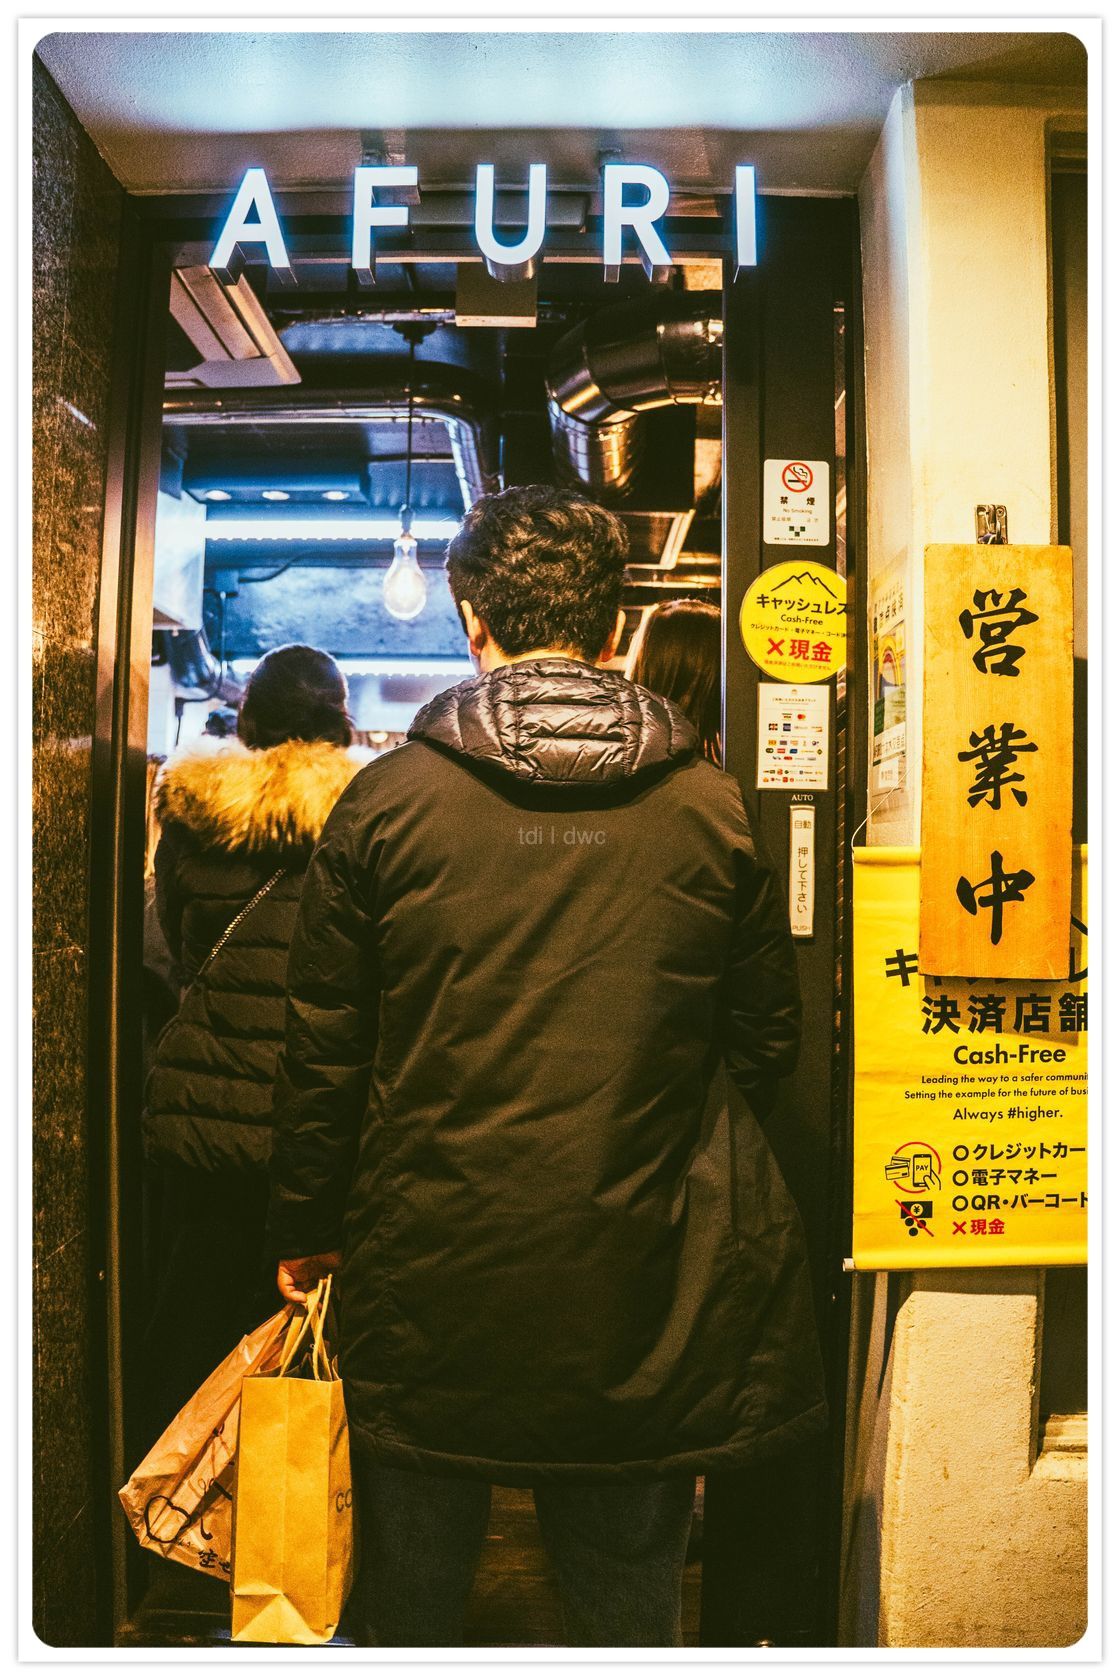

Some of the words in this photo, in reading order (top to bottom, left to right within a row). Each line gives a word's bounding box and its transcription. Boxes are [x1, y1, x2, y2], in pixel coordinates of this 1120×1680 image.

[209, 163, 757, 269] AFURI
[780, 614, 823, 625] Cash-Free
[956, 588, 1039, 945] 営業中
[794, 820, 811, 829] 自動
[797, 847, 808, 913] 押して下さい
[921, 992, 1088, 1035] 決済店舗
[953, 1044, 1066, 1065] Cash-Free
[921, 1075, 958, 1085] Leading
[961, 1075, 975, 1083] the
[978, 1076, 998, 1084] way
[1020, 1073, 1043, 1082] safer
[1045, 1072, 1088, 1081] communi
[904, 1091, 936, 1101] Setting
[939, 1090, 952, 1098] the
[955, 1089, 995, 1100] example
[998, 1089, 1011, 1098] for
[1013, 1088, 1028, 1097] the
[1030, 1087, 1056, 1097] future
[1059, 1086, 1069, 1095] of
[953, 1108, 1003, 1123] Always
[1007, 1106, 1063, 1122] #higher.
